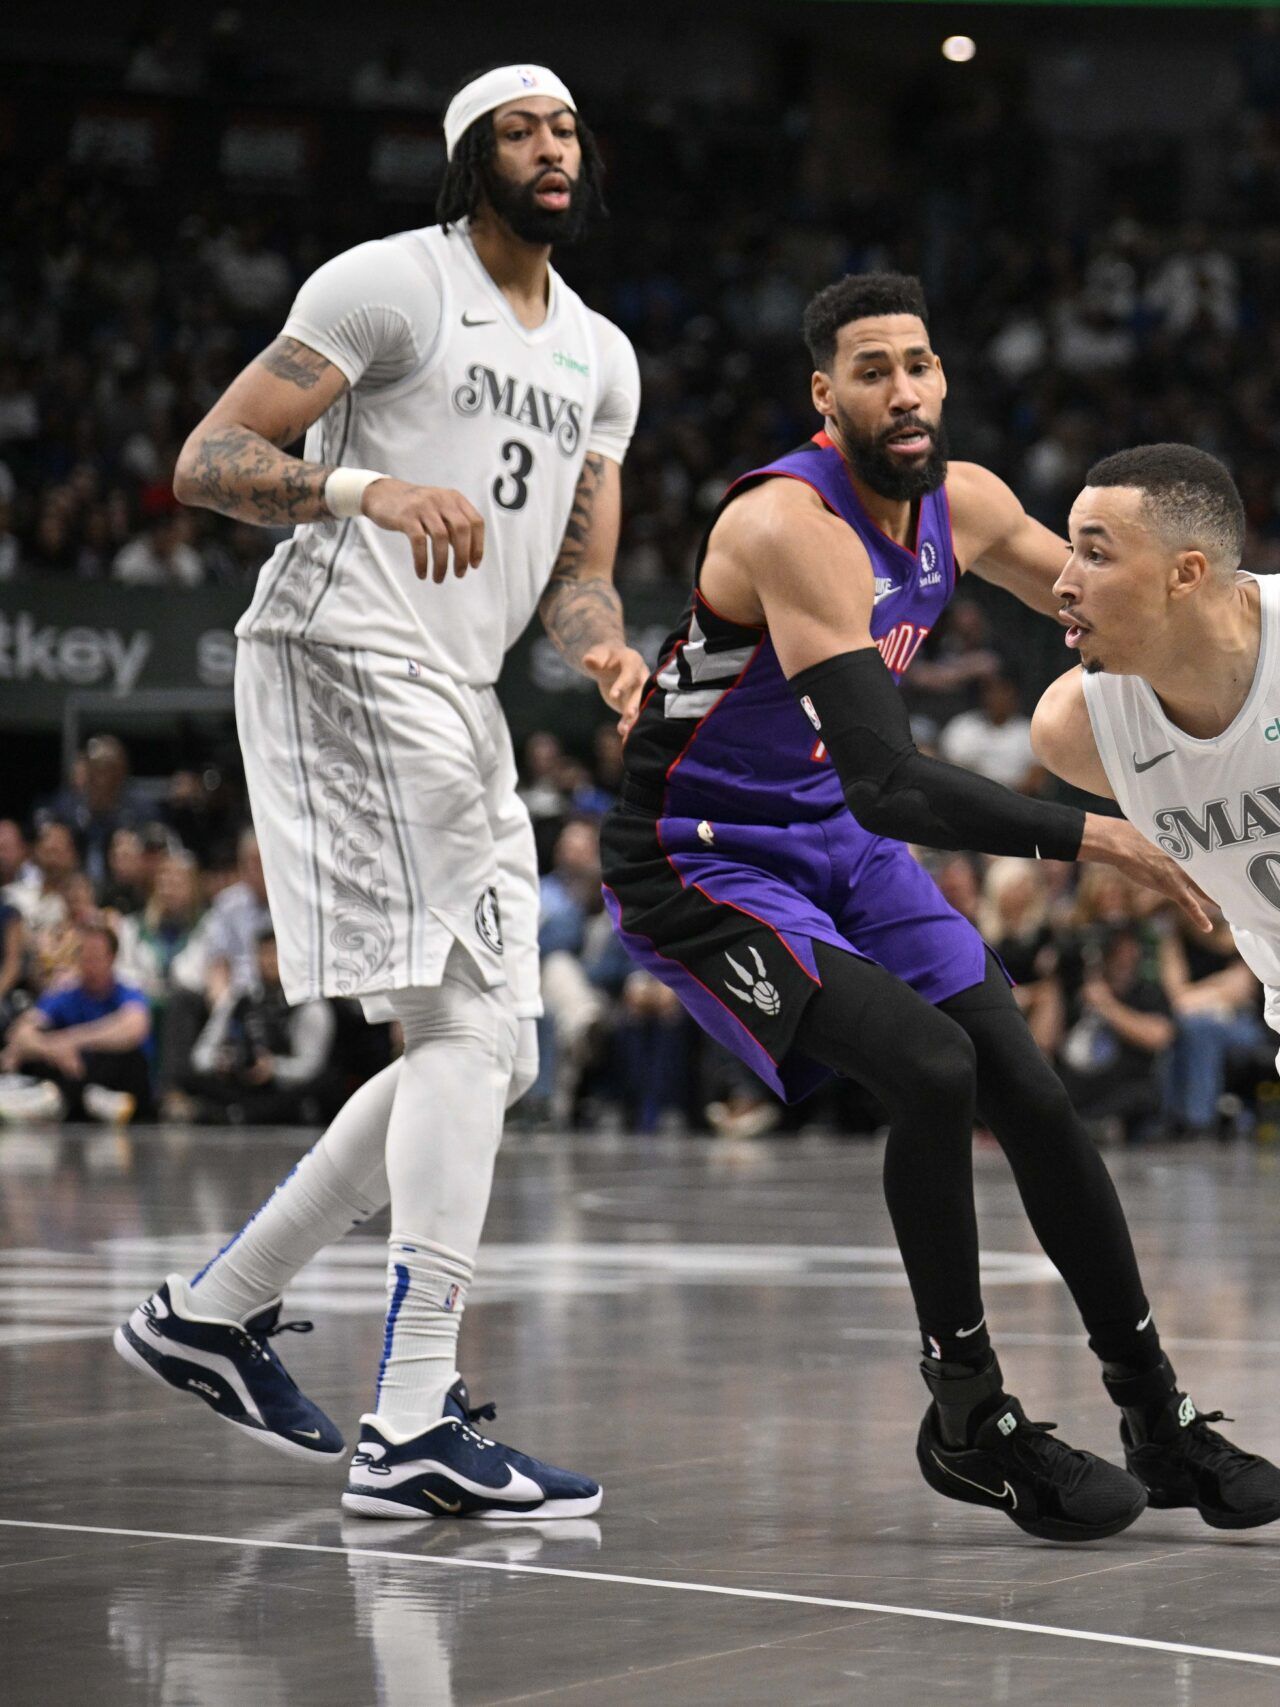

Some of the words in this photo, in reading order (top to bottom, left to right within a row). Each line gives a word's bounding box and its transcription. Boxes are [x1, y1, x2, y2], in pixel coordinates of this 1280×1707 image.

[552, 352, 590, 377] chime
[452, 364, 584, 458] MAVS
[492, 438, 534, 512] 3
